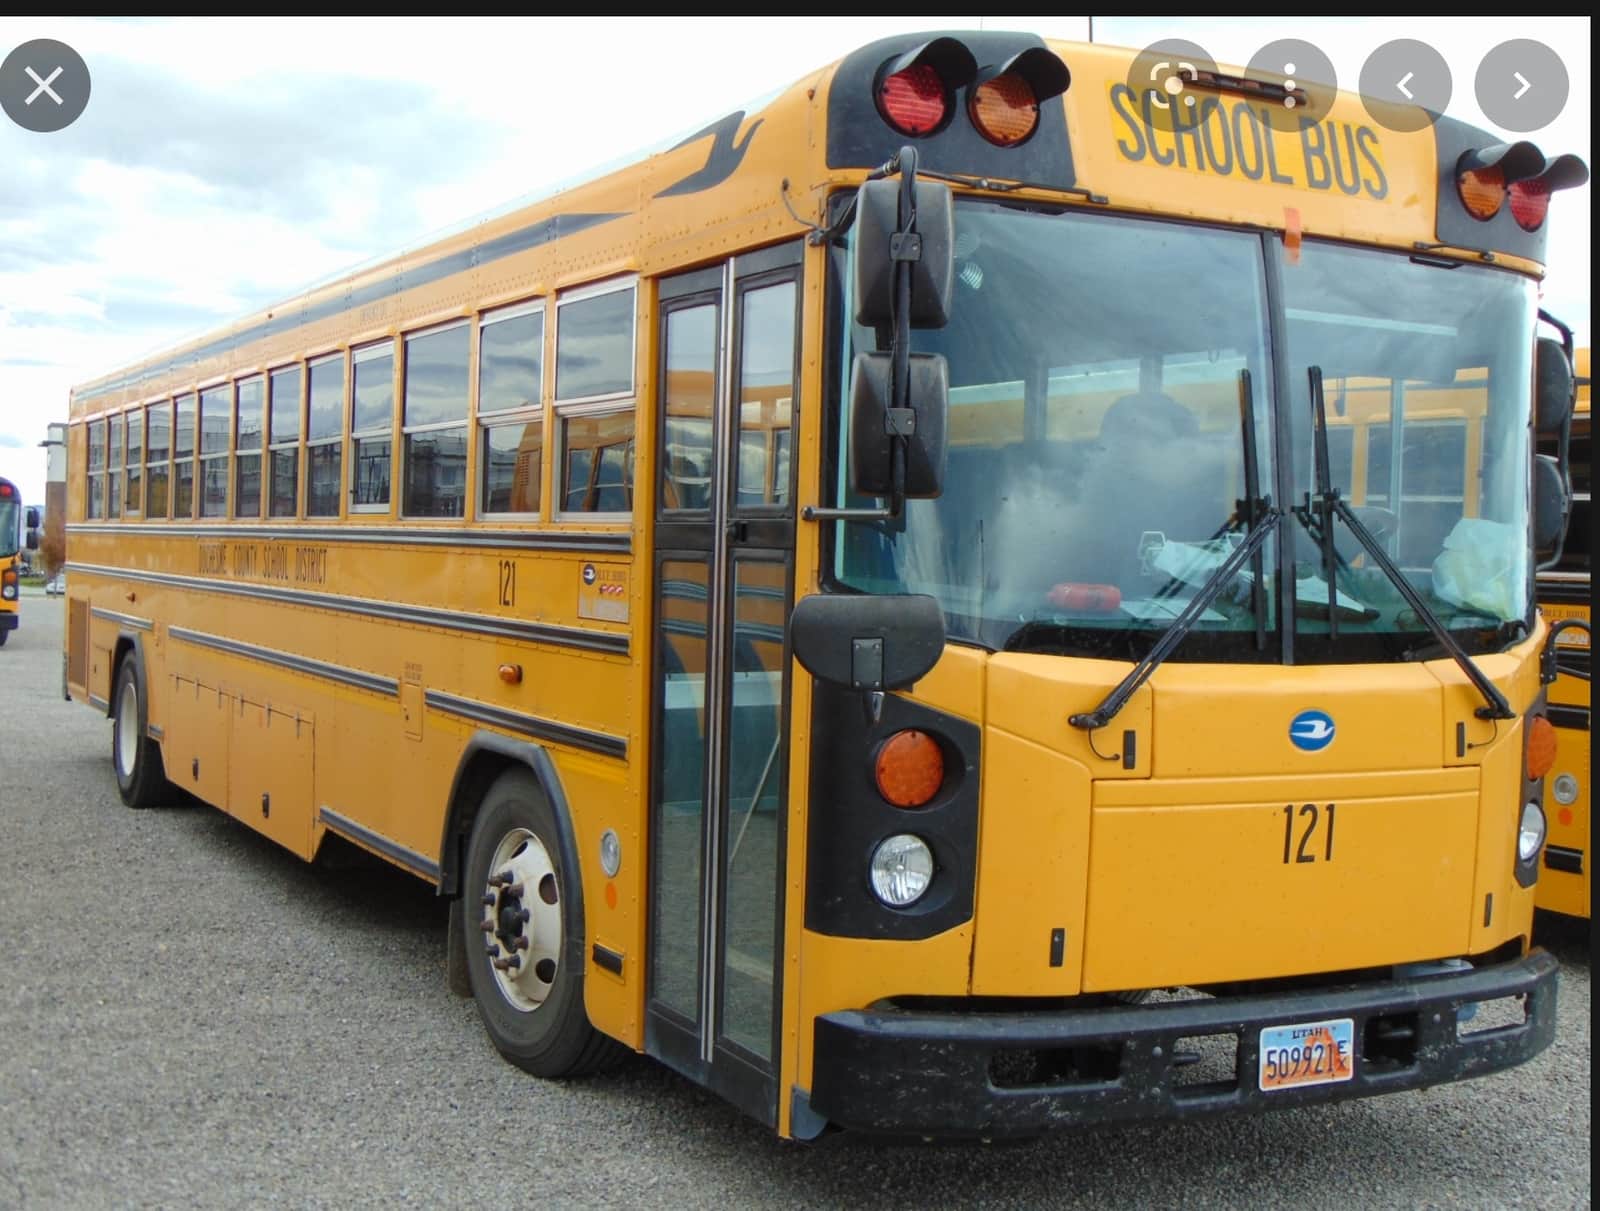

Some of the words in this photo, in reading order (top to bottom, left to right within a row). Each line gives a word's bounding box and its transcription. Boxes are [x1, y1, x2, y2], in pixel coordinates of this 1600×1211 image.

[1110, 83, 1294, 185] SCHOOL
[1300, 117, 1389, 200] BUS
[296, 547, 328, 585] DISTRICT
[498, 559, 516, 607] 121
[1283, 803, 1336, 864] 121
[1292, 1027, 1323, 1040] UTAH
[1267, 1043, 1334, 1079] 509921
